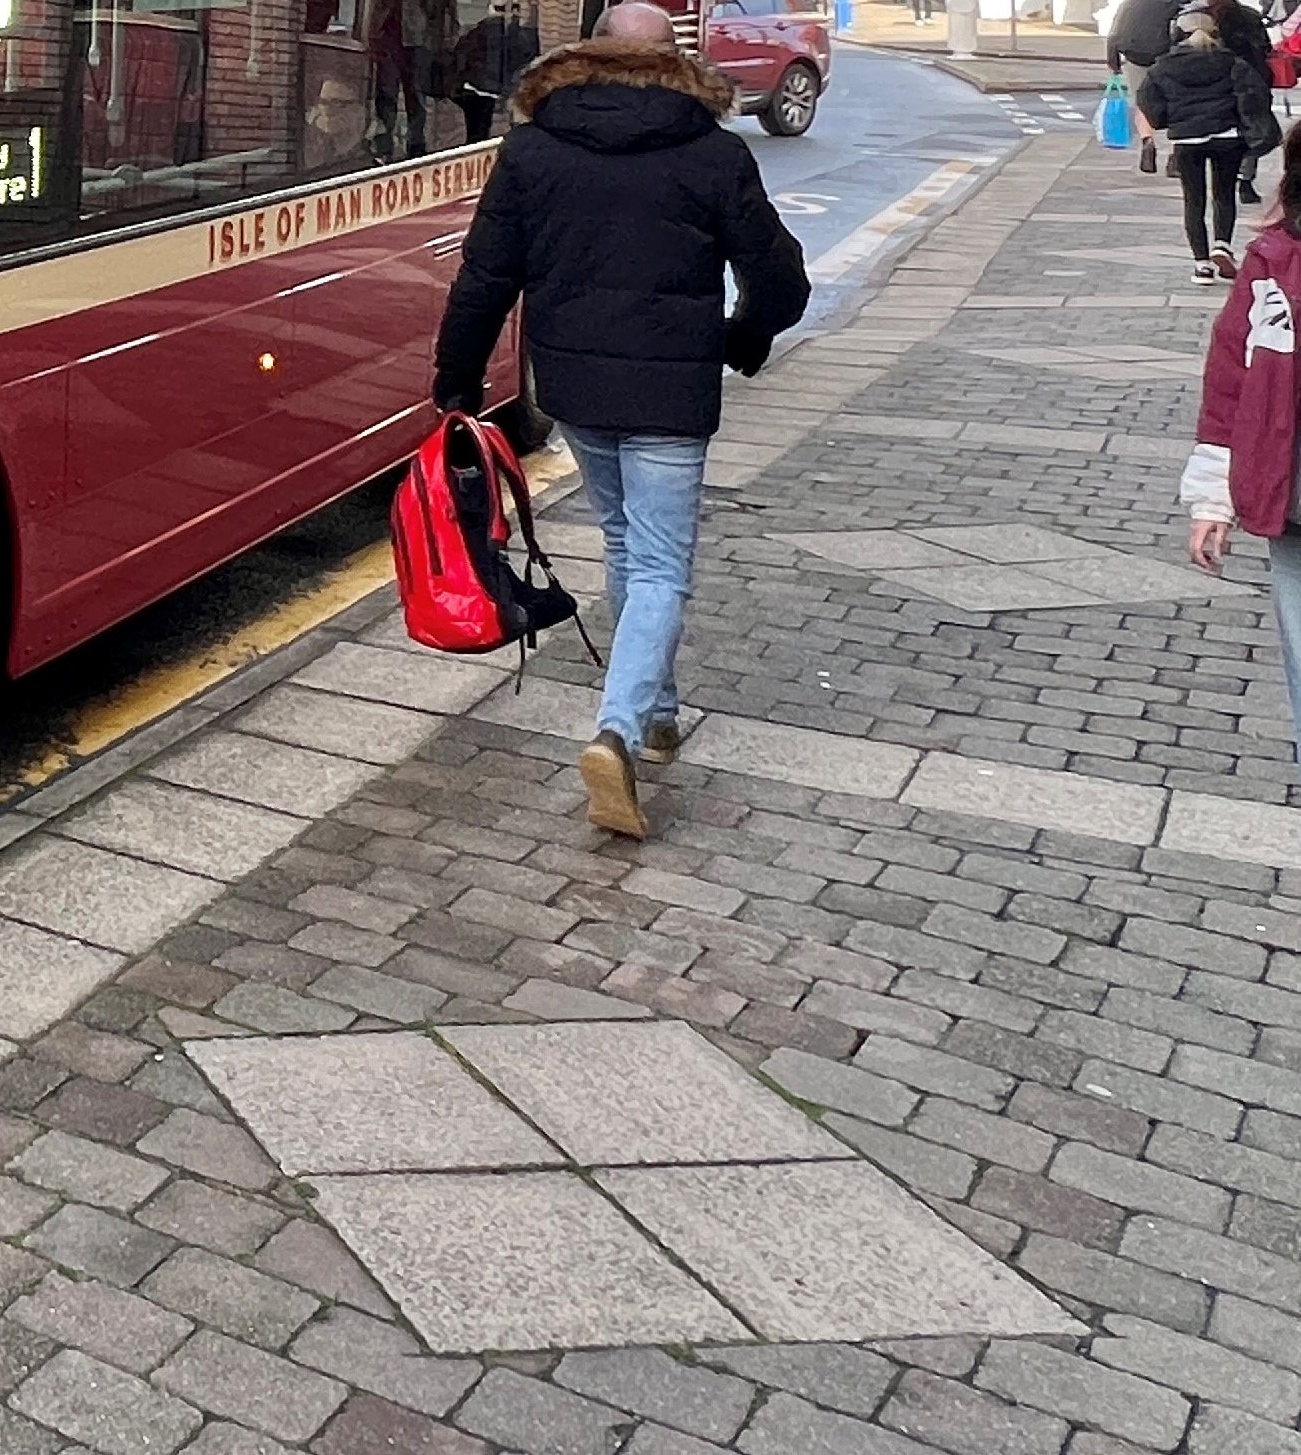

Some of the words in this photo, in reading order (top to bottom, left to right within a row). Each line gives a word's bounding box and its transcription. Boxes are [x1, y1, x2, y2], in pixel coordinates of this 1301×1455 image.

[28, 126, 44, 199] 1
[208, 211, 266, 263] ISLE
[276, 201, 306, 245] OF
[316, 186, 363, 235] MAN
[371, 173, 424, 218] ROAD
